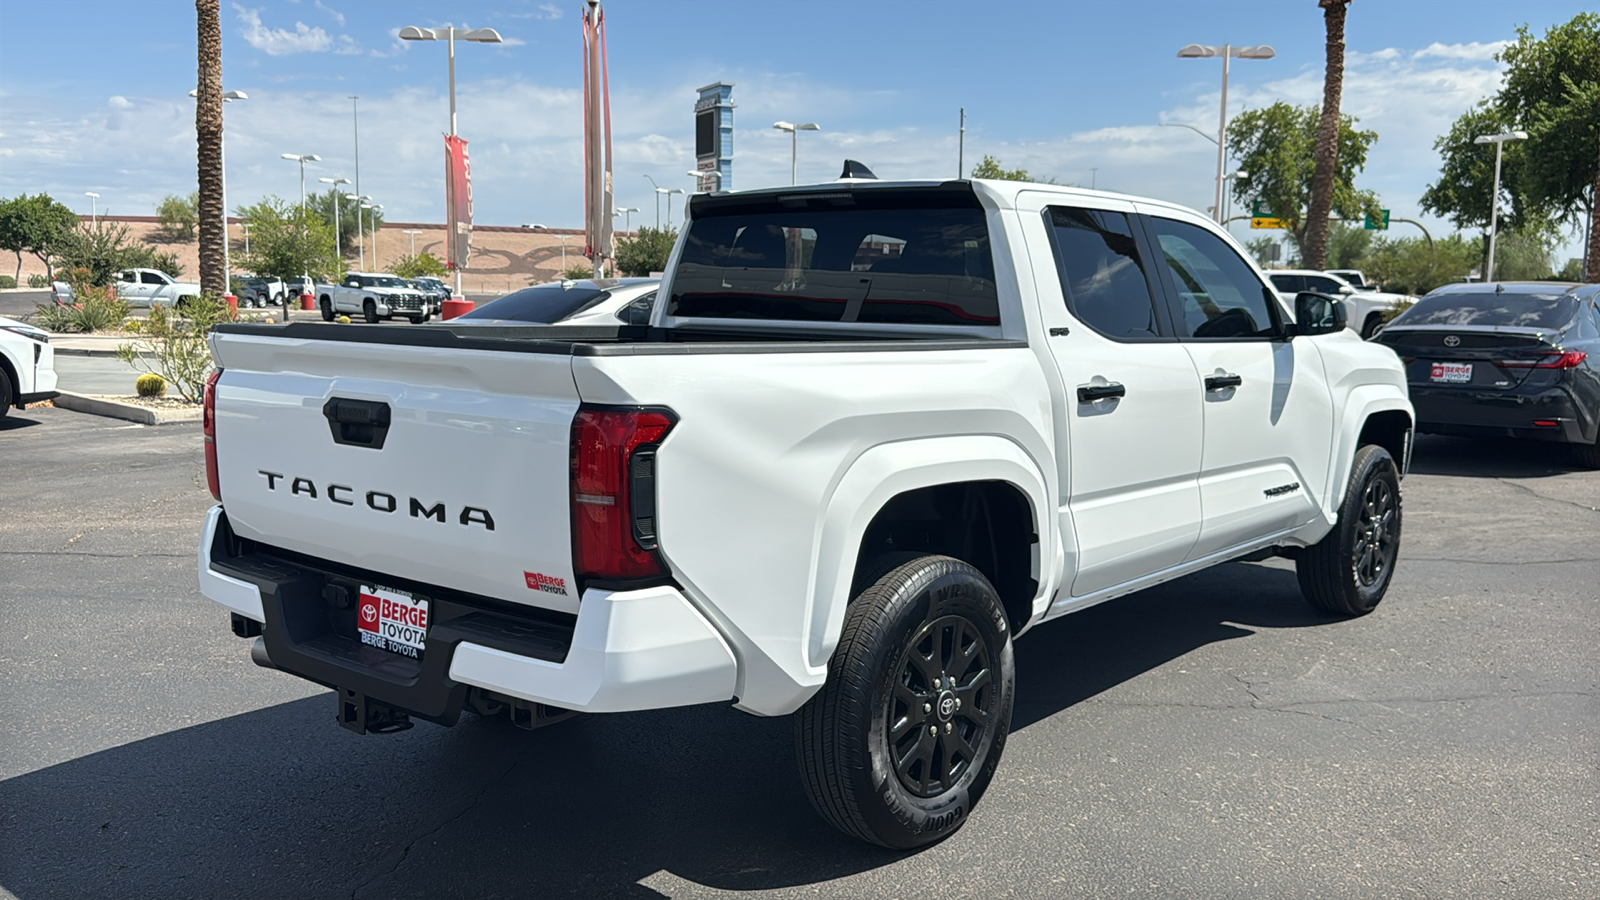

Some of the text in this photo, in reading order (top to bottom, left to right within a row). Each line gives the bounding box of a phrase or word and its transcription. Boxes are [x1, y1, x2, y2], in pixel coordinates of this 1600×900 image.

[258, 469, 496, 531] TACOMA
[537, 573, 566, 588] BERGE
[539, 584, 569, 597] TOYOTA
[382, 598, 426, 628] BERGE
[361, 631, 418, 658] BERGE TOYOTA
[381, 621, 427, 646] TOYOTA
